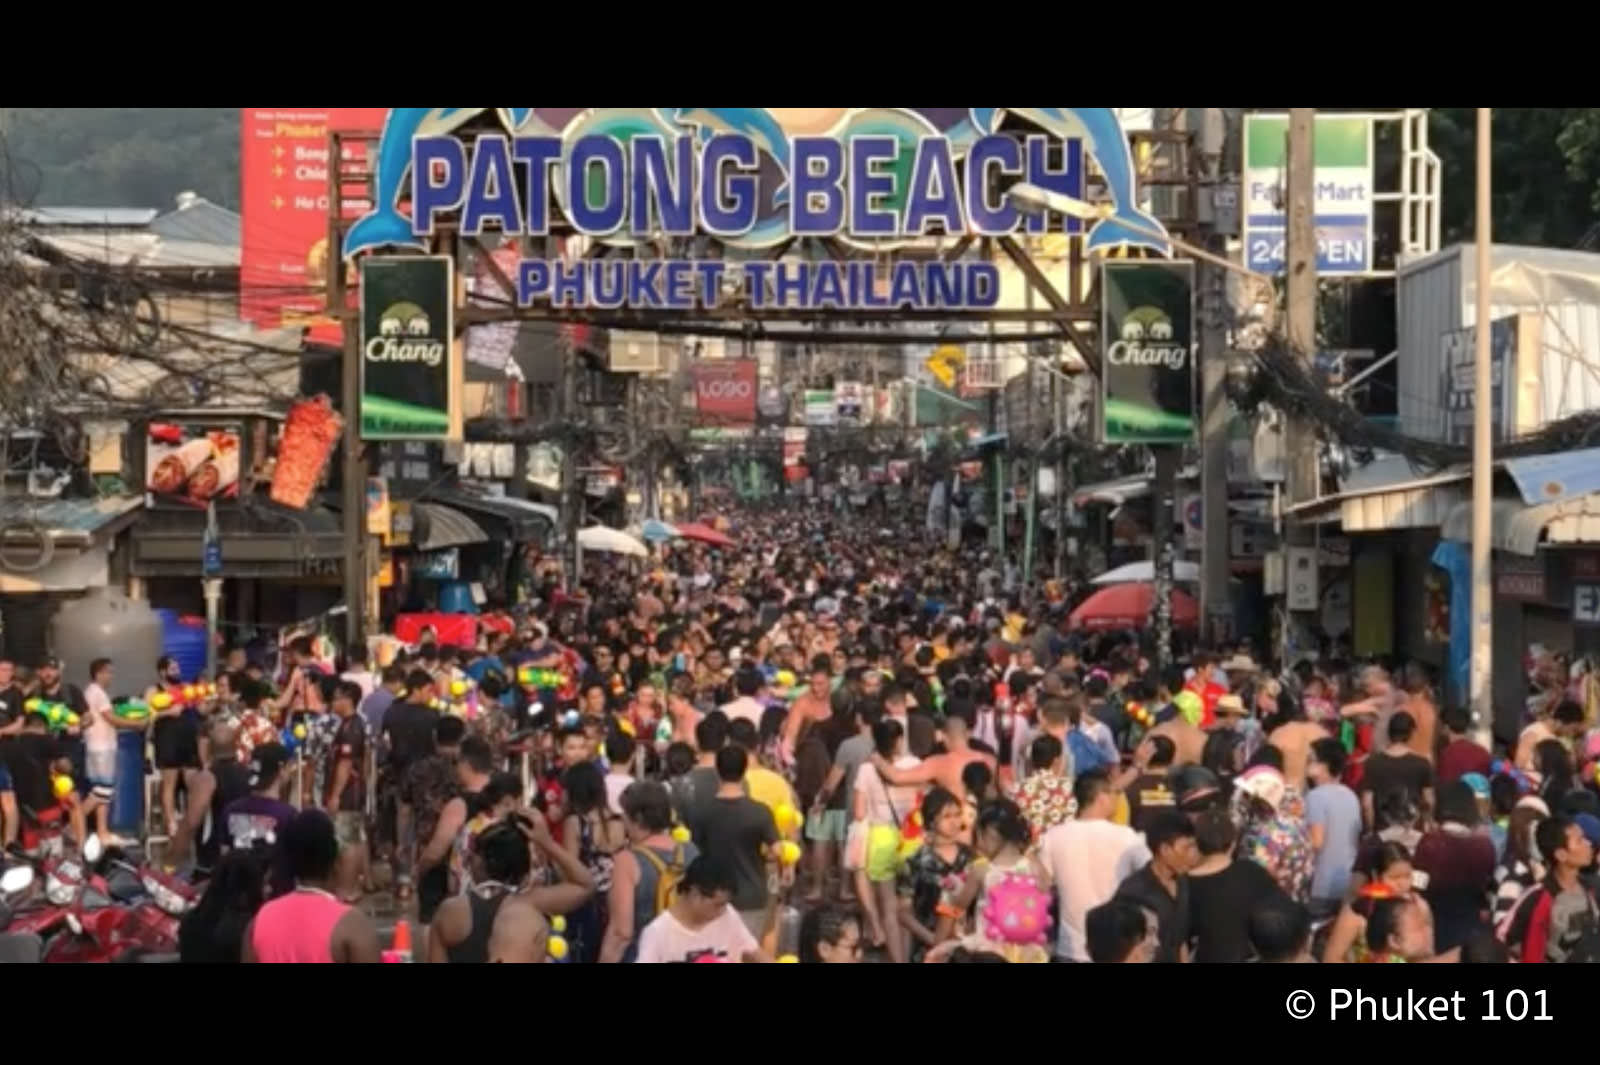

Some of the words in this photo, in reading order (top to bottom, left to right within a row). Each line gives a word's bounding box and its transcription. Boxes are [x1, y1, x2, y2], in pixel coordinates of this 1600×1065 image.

[411, 134, 761, 236] PATONG
[789, 134, 1083, 236] BEACH
[1251, 182, 1365, 200] FaMart
[517, 258, 723, 309] PHUKET
[745, 258, 999, 309] THAILAND
[366, 336, 444, 367] Chang
[1108, 340, 1186, 370] Chang
